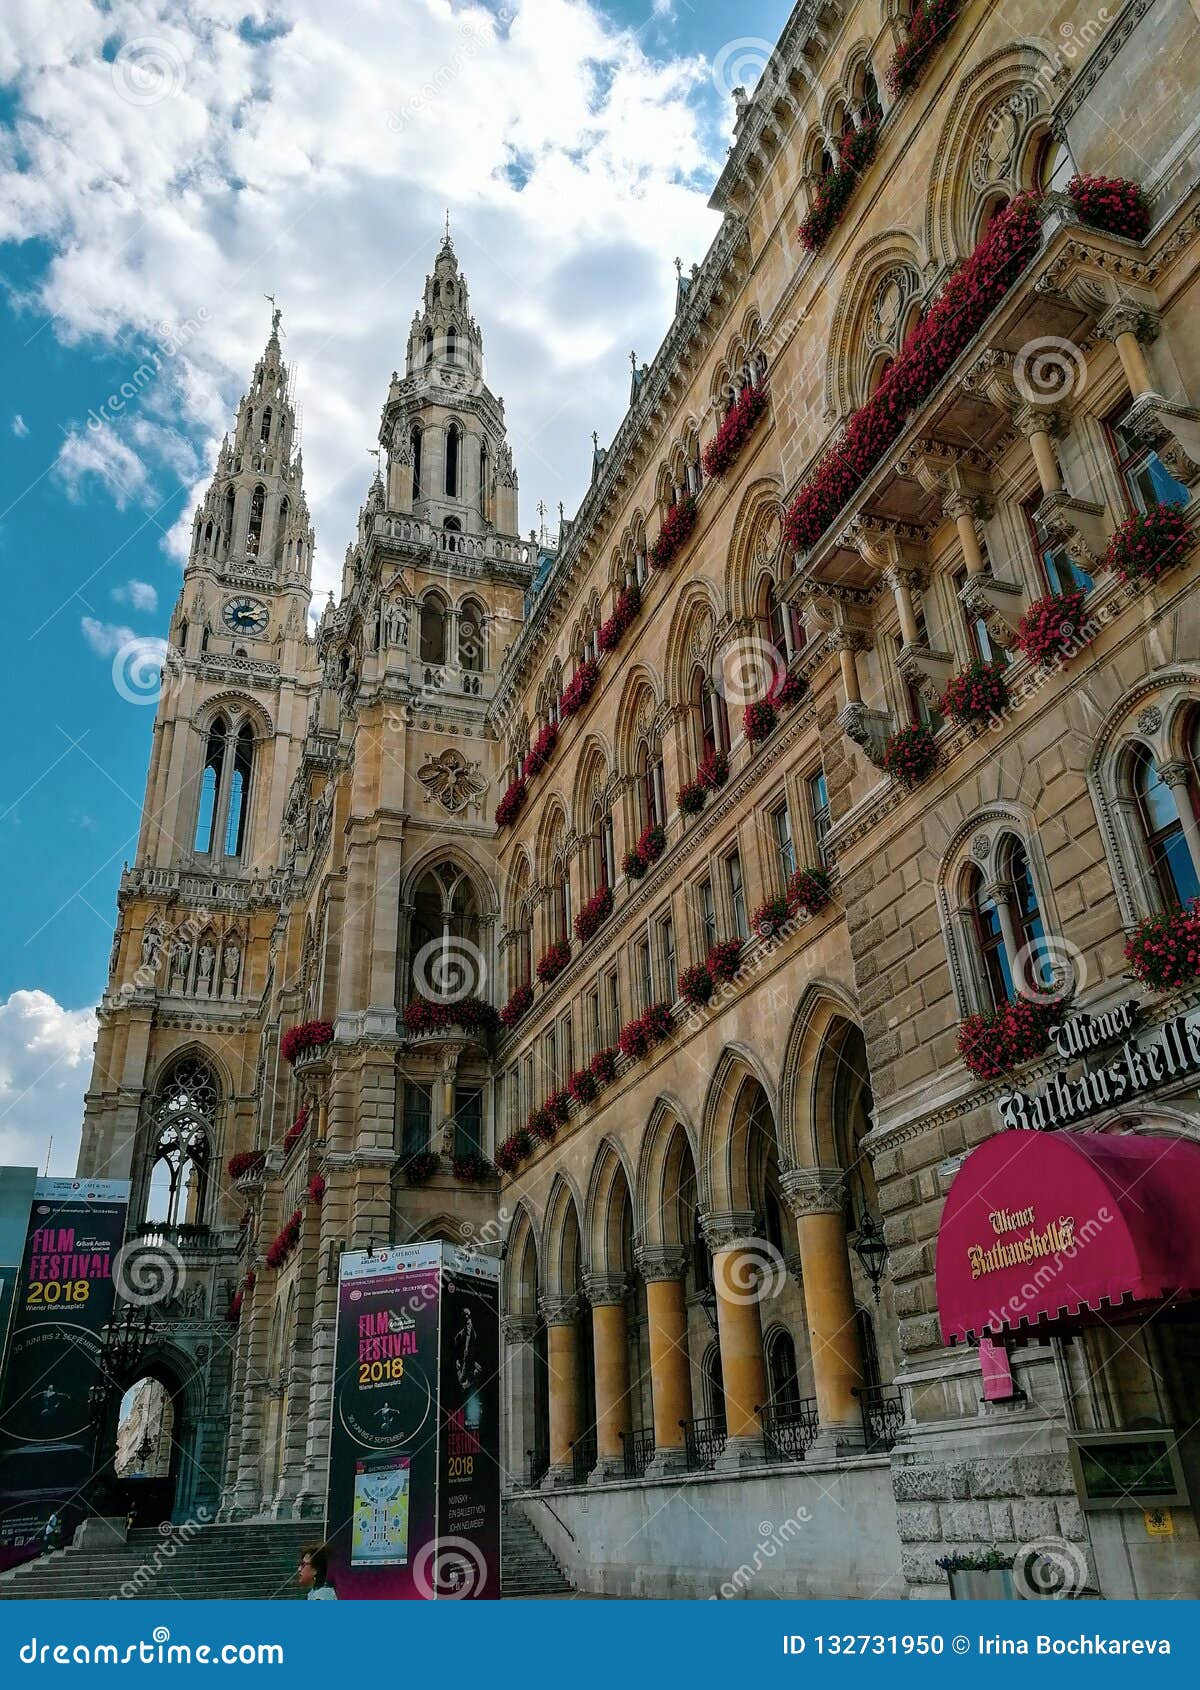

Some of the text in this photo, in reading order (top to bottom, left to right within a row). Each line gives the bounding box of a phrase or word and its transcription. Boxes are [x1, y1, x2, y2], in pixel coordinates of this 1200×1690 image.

[1049, 1001, 1137, 1058] Wiener
[989, 1206, 1035, 1235] Wiener
[32, 1228, 75, 1253] FILM
[968, 1216, 1075, 1280] Rathauskeller
[29, 1253, 112, 1280] FESTIVAL
[26, 1280, 90, 1303] 2018
[359, 1311, 389, 1338] FILM
[359, 1331, 419, 1362] FESTIVAL
[359, 1357, 404, 1384] 2018
[448, 1455, 474, 1477] 2018
